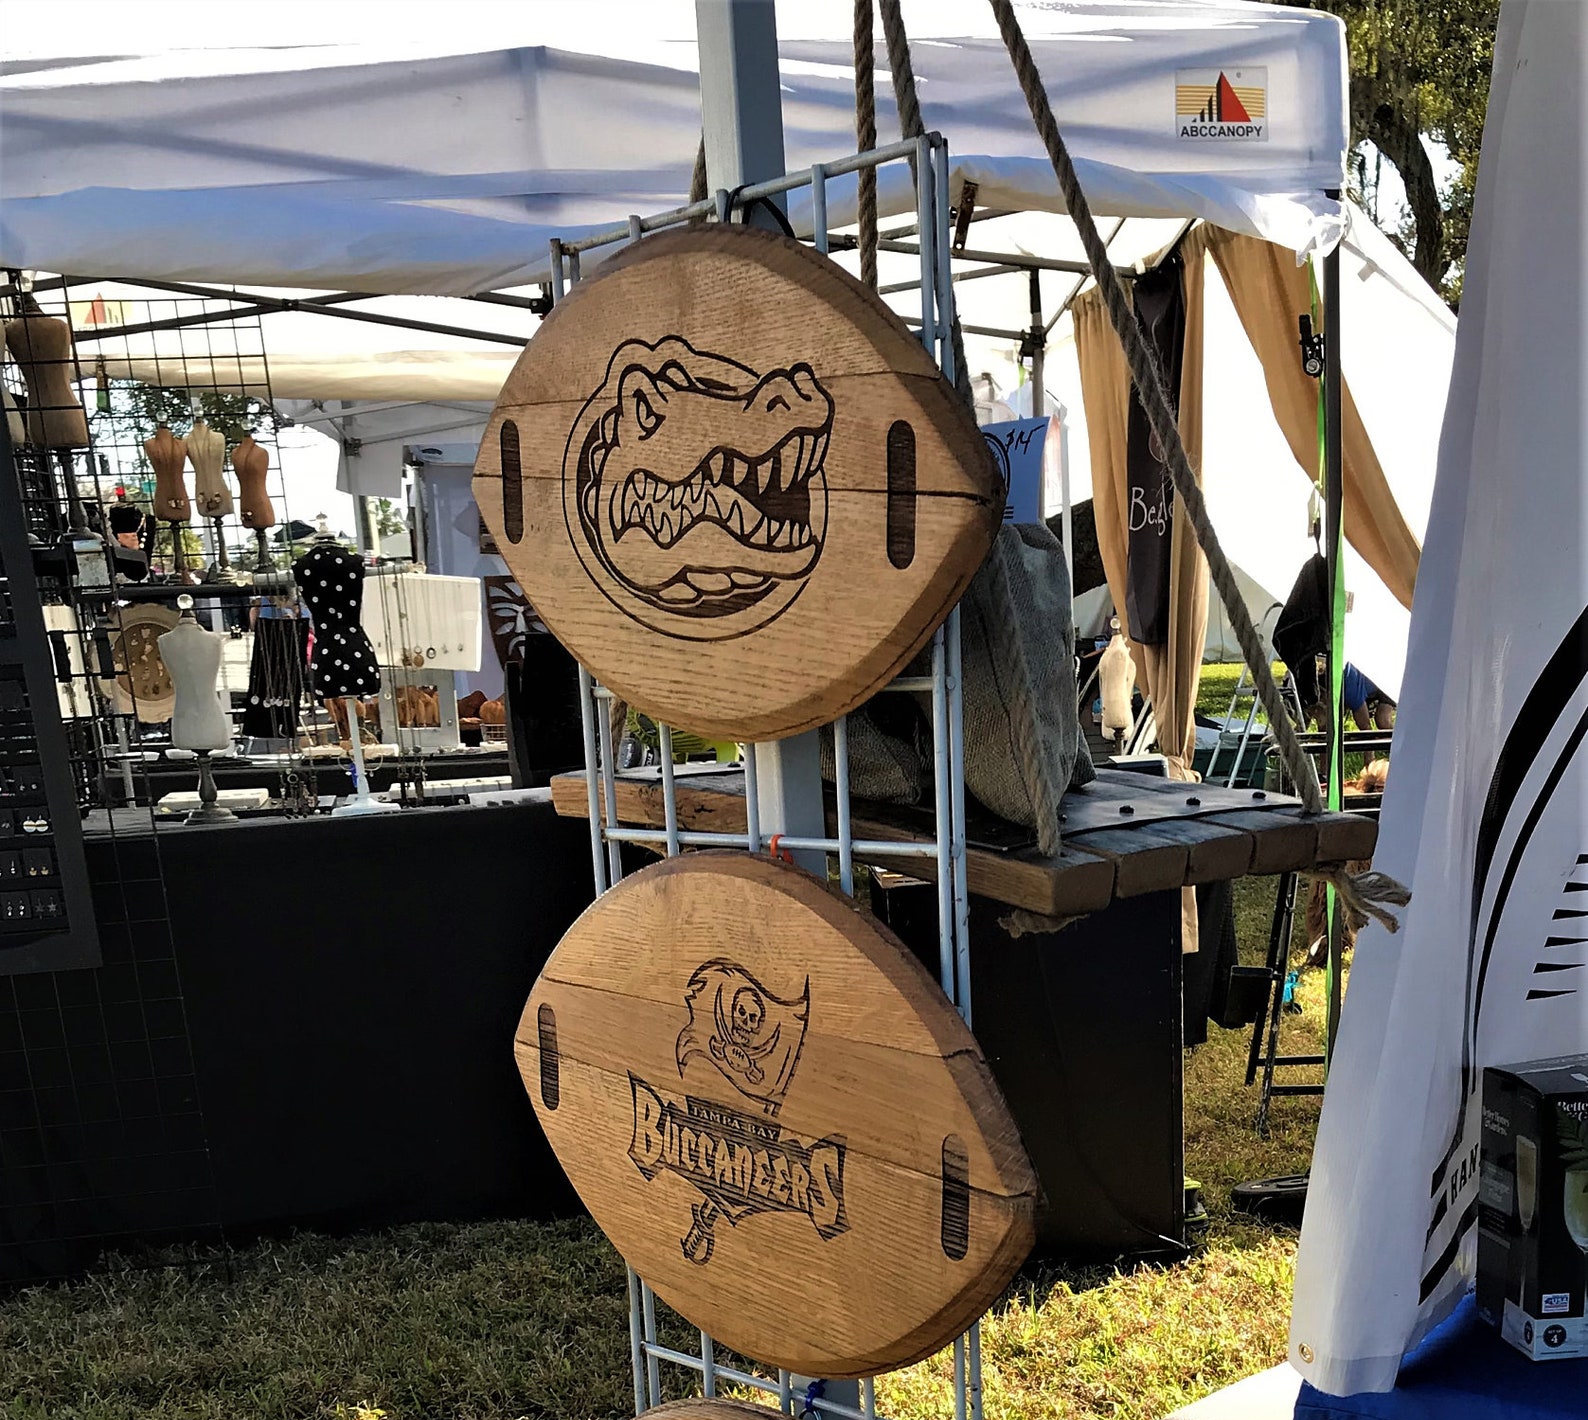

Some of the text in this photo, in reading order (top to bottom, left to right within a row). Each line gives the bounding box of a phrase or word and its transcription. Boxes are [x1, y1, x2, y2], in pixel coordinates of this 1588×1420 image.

[1180, 125, 1263, 138] ABCCANOPY
[692, 1105, 777, 1141] TAMPA BAY
[629, 1074, 848, 1233] BUCCANEERS
[1551, 1334, 1558, 1344] 4
